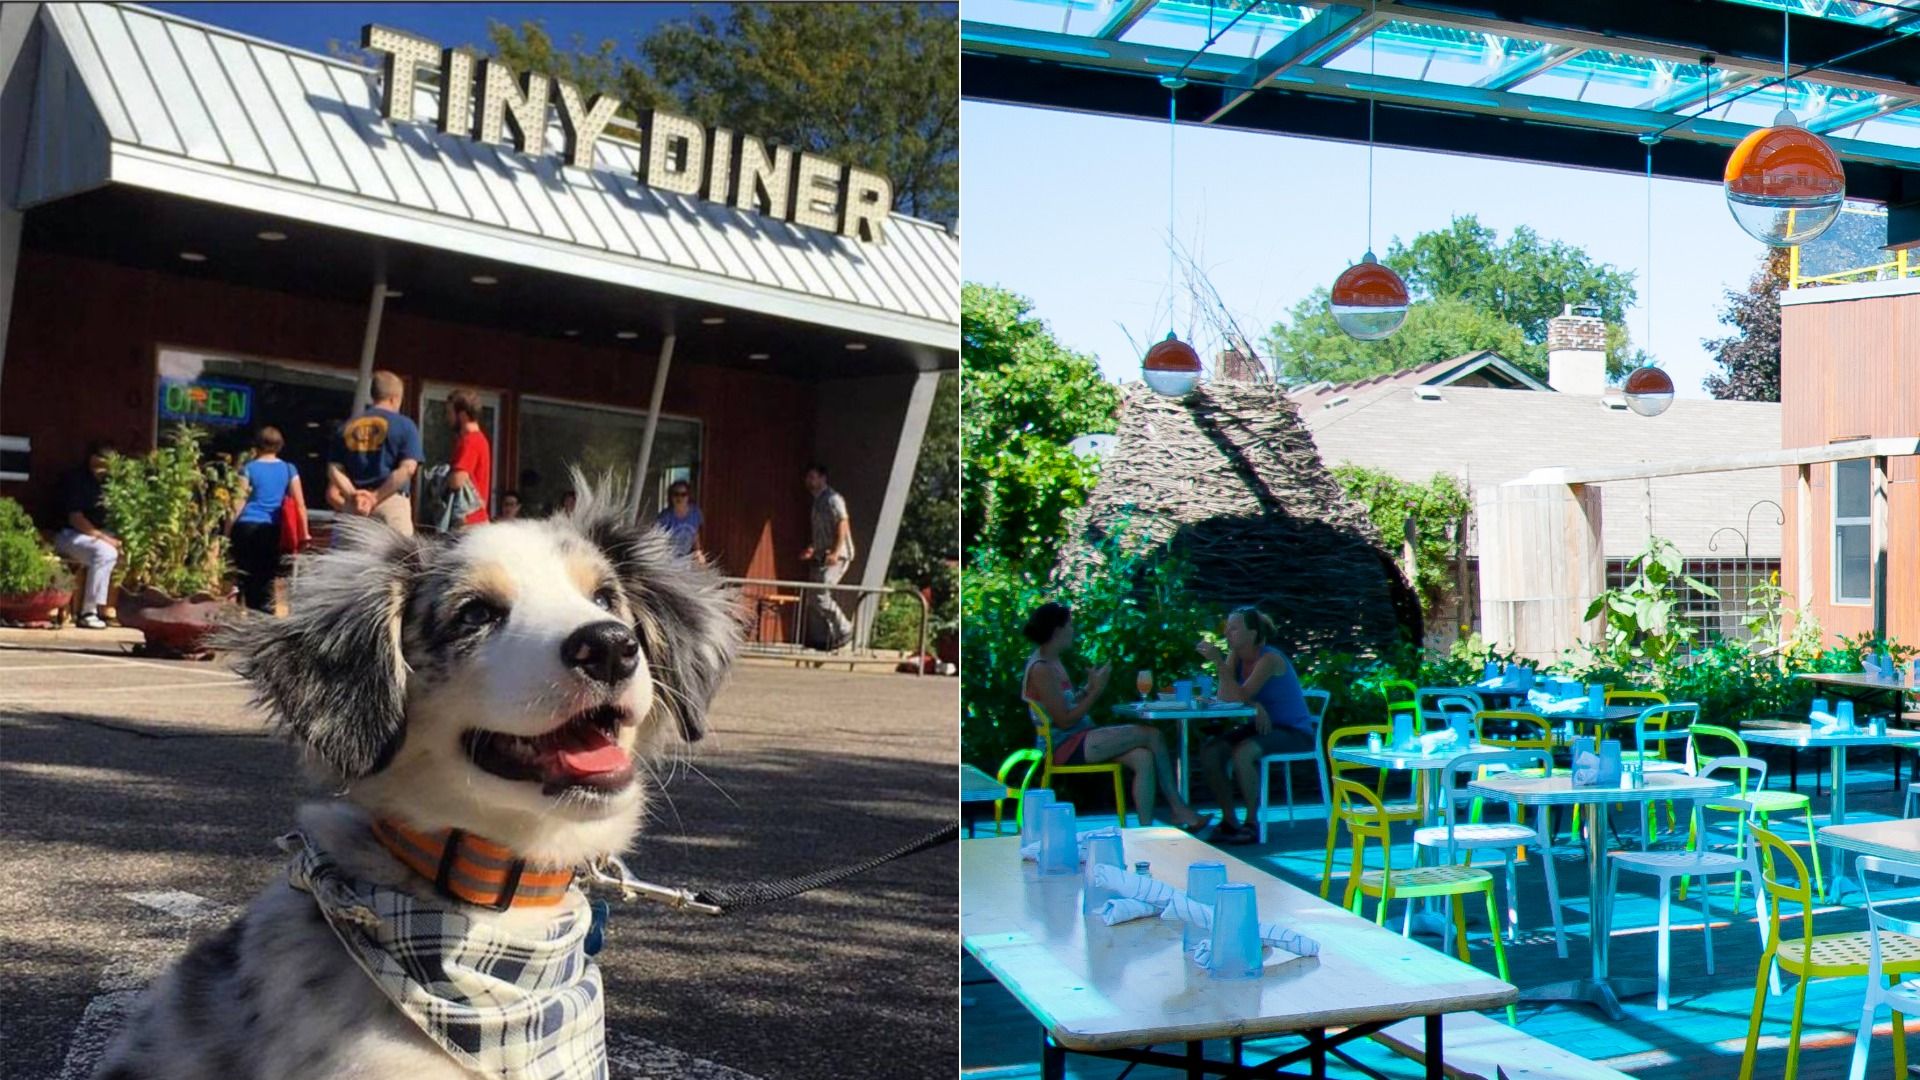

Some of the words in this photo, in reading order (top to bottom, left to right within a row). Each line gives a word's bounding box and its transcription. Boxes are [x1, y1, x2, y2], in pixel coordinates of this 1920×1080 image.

[361, 23, 621, 170] TINY
[639, 108, 893, 245] DINER
[166, 383, 247, 418] OPEN
